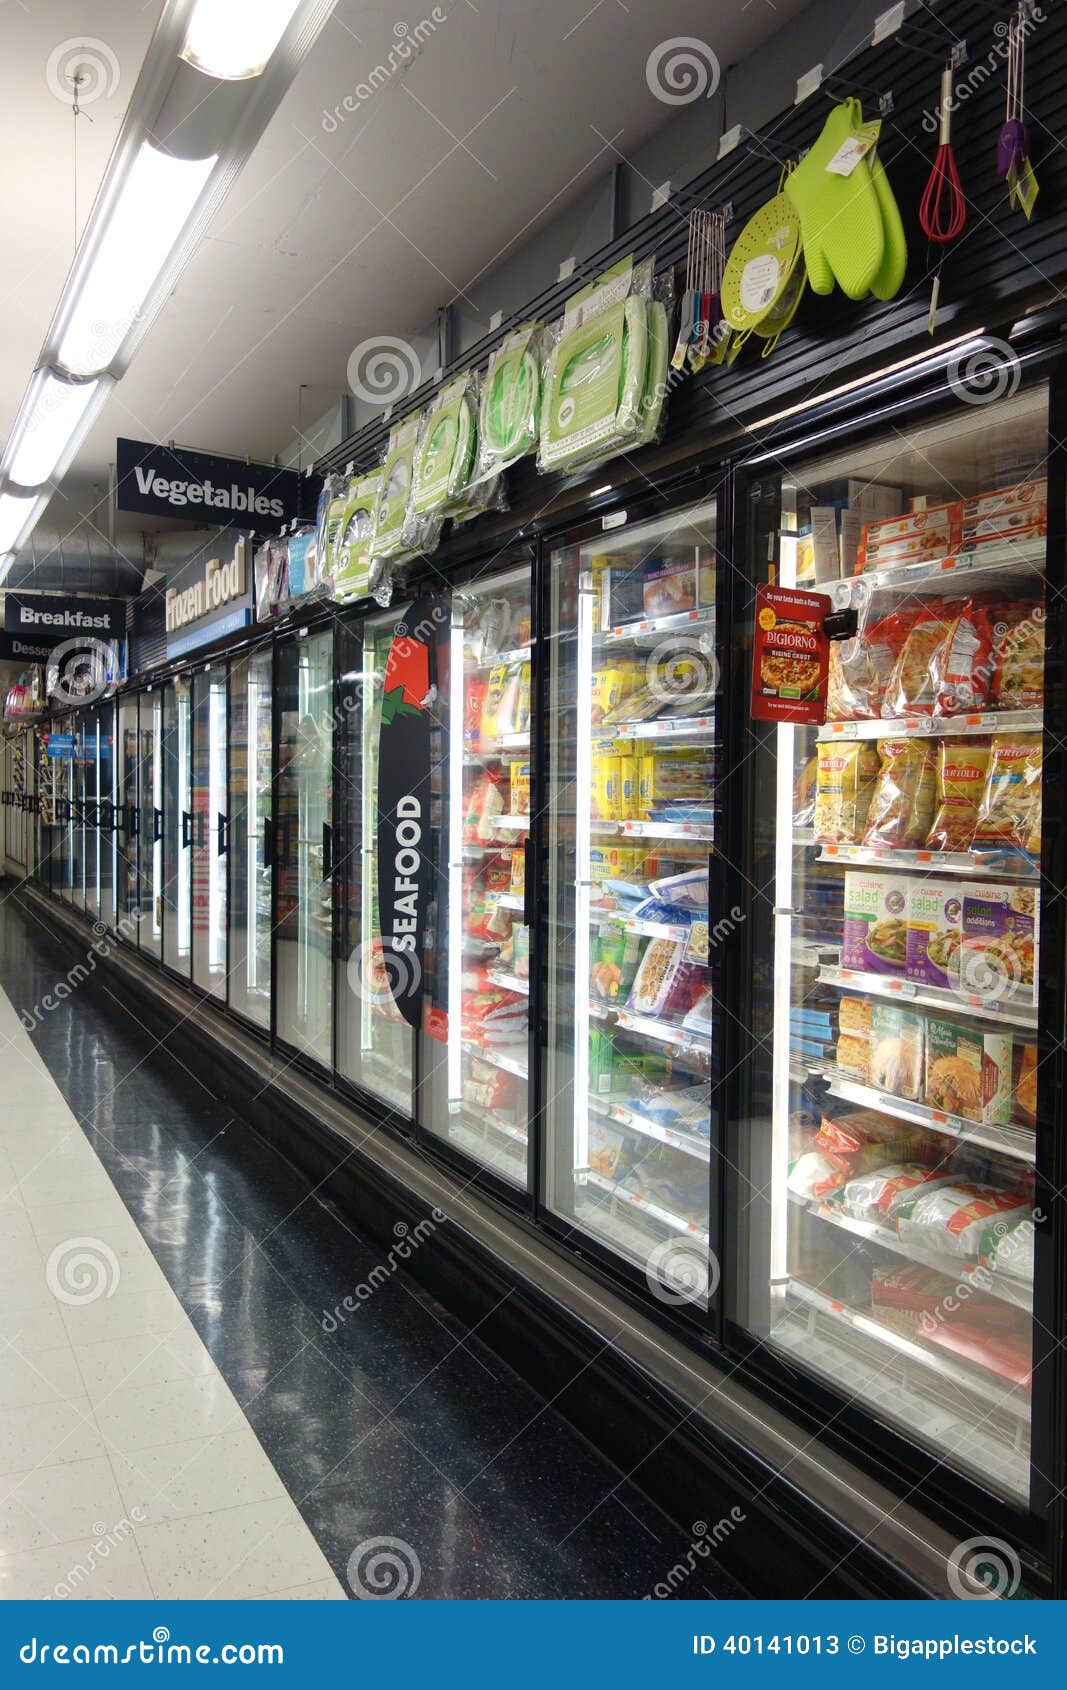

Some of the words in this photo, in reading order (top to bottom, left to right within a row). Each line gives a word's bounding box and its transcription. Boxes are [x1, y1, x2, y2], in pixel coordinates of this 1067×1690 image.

[135, 466, 284, 518] Vegetables
[20, 607, 110, 628] Breakfast
[166, 581, 207, 632] Frozen
[206, 541, 246, 611] Food
[391, 795, 422, 952] SEAFOOD
